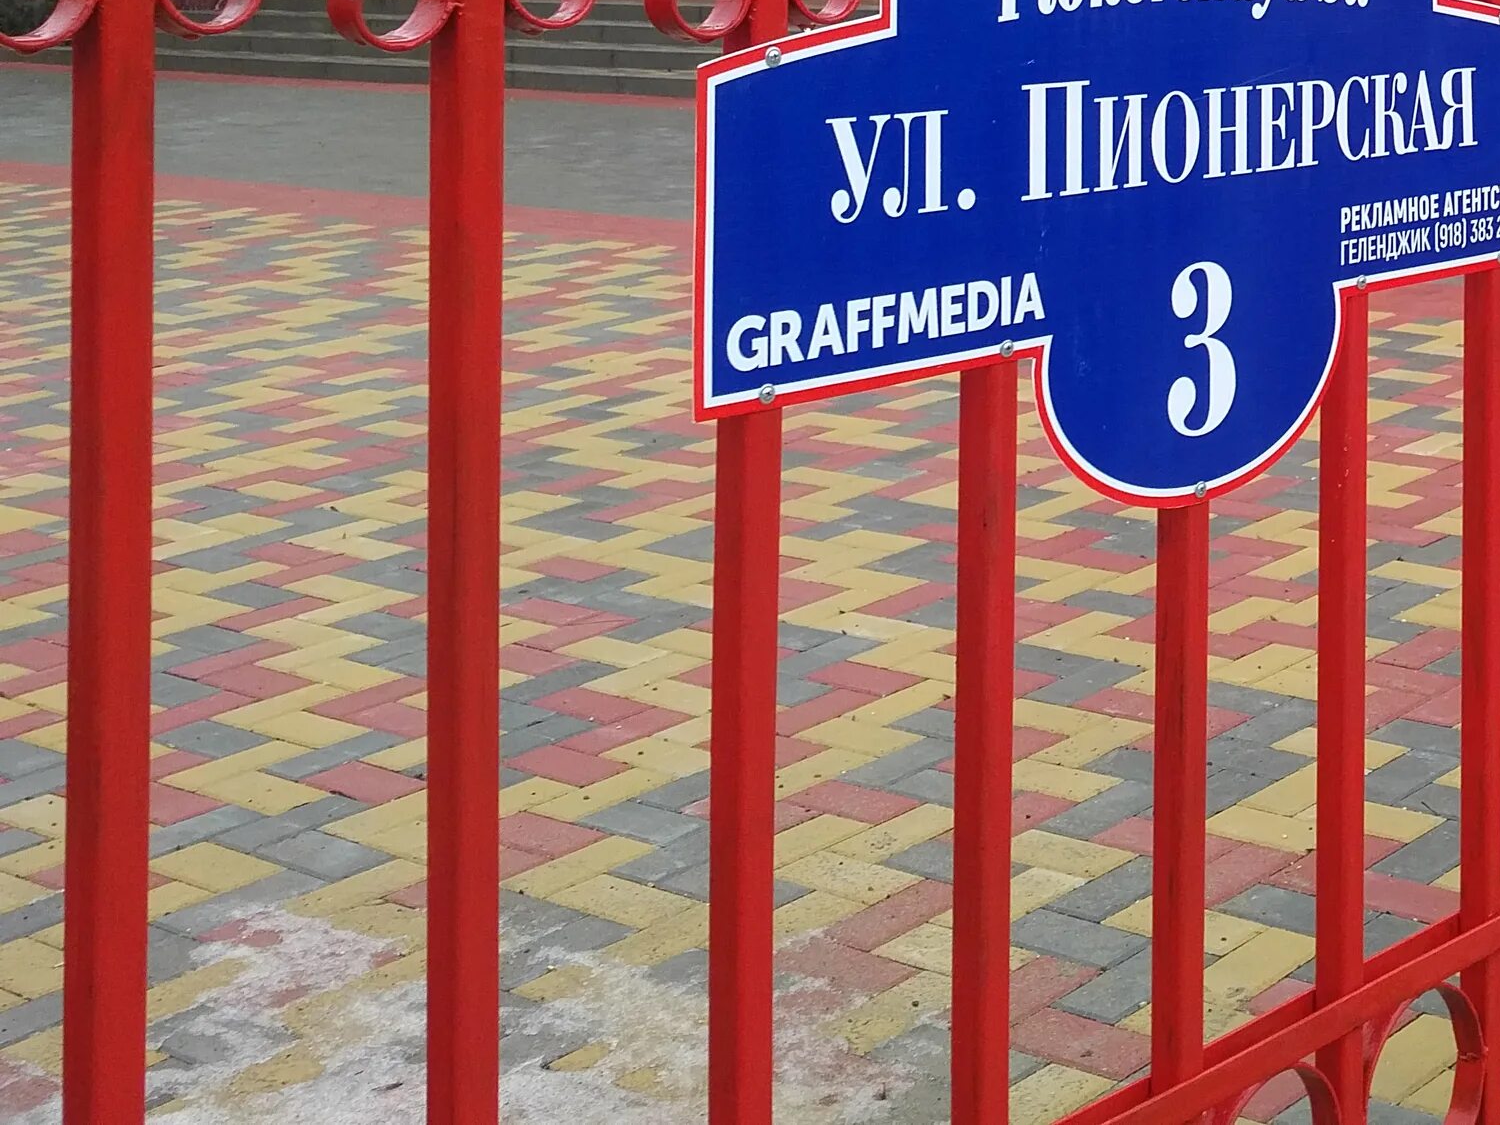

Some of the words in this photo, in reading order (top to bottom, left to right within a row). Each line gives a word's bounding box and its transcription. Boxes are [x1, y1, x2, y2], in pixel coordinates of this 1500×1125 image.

[825, 109, 976, 224] УЛ.
[1020, 67, 1479, 202] ПИОНЕРСКАЯ
[1340, 193, 1440, 234] РЕКЛАМНОЕ
[1340, 226, 1431, 266] ГЕЛЕНДЖИК
[1434, 217, 1467, 253] (918)
[1469, 216, 1494, 244] 383
[727, 272, 1046, 372] GRAFFMEDIA
[1167, 261, 1237, 437] 3
